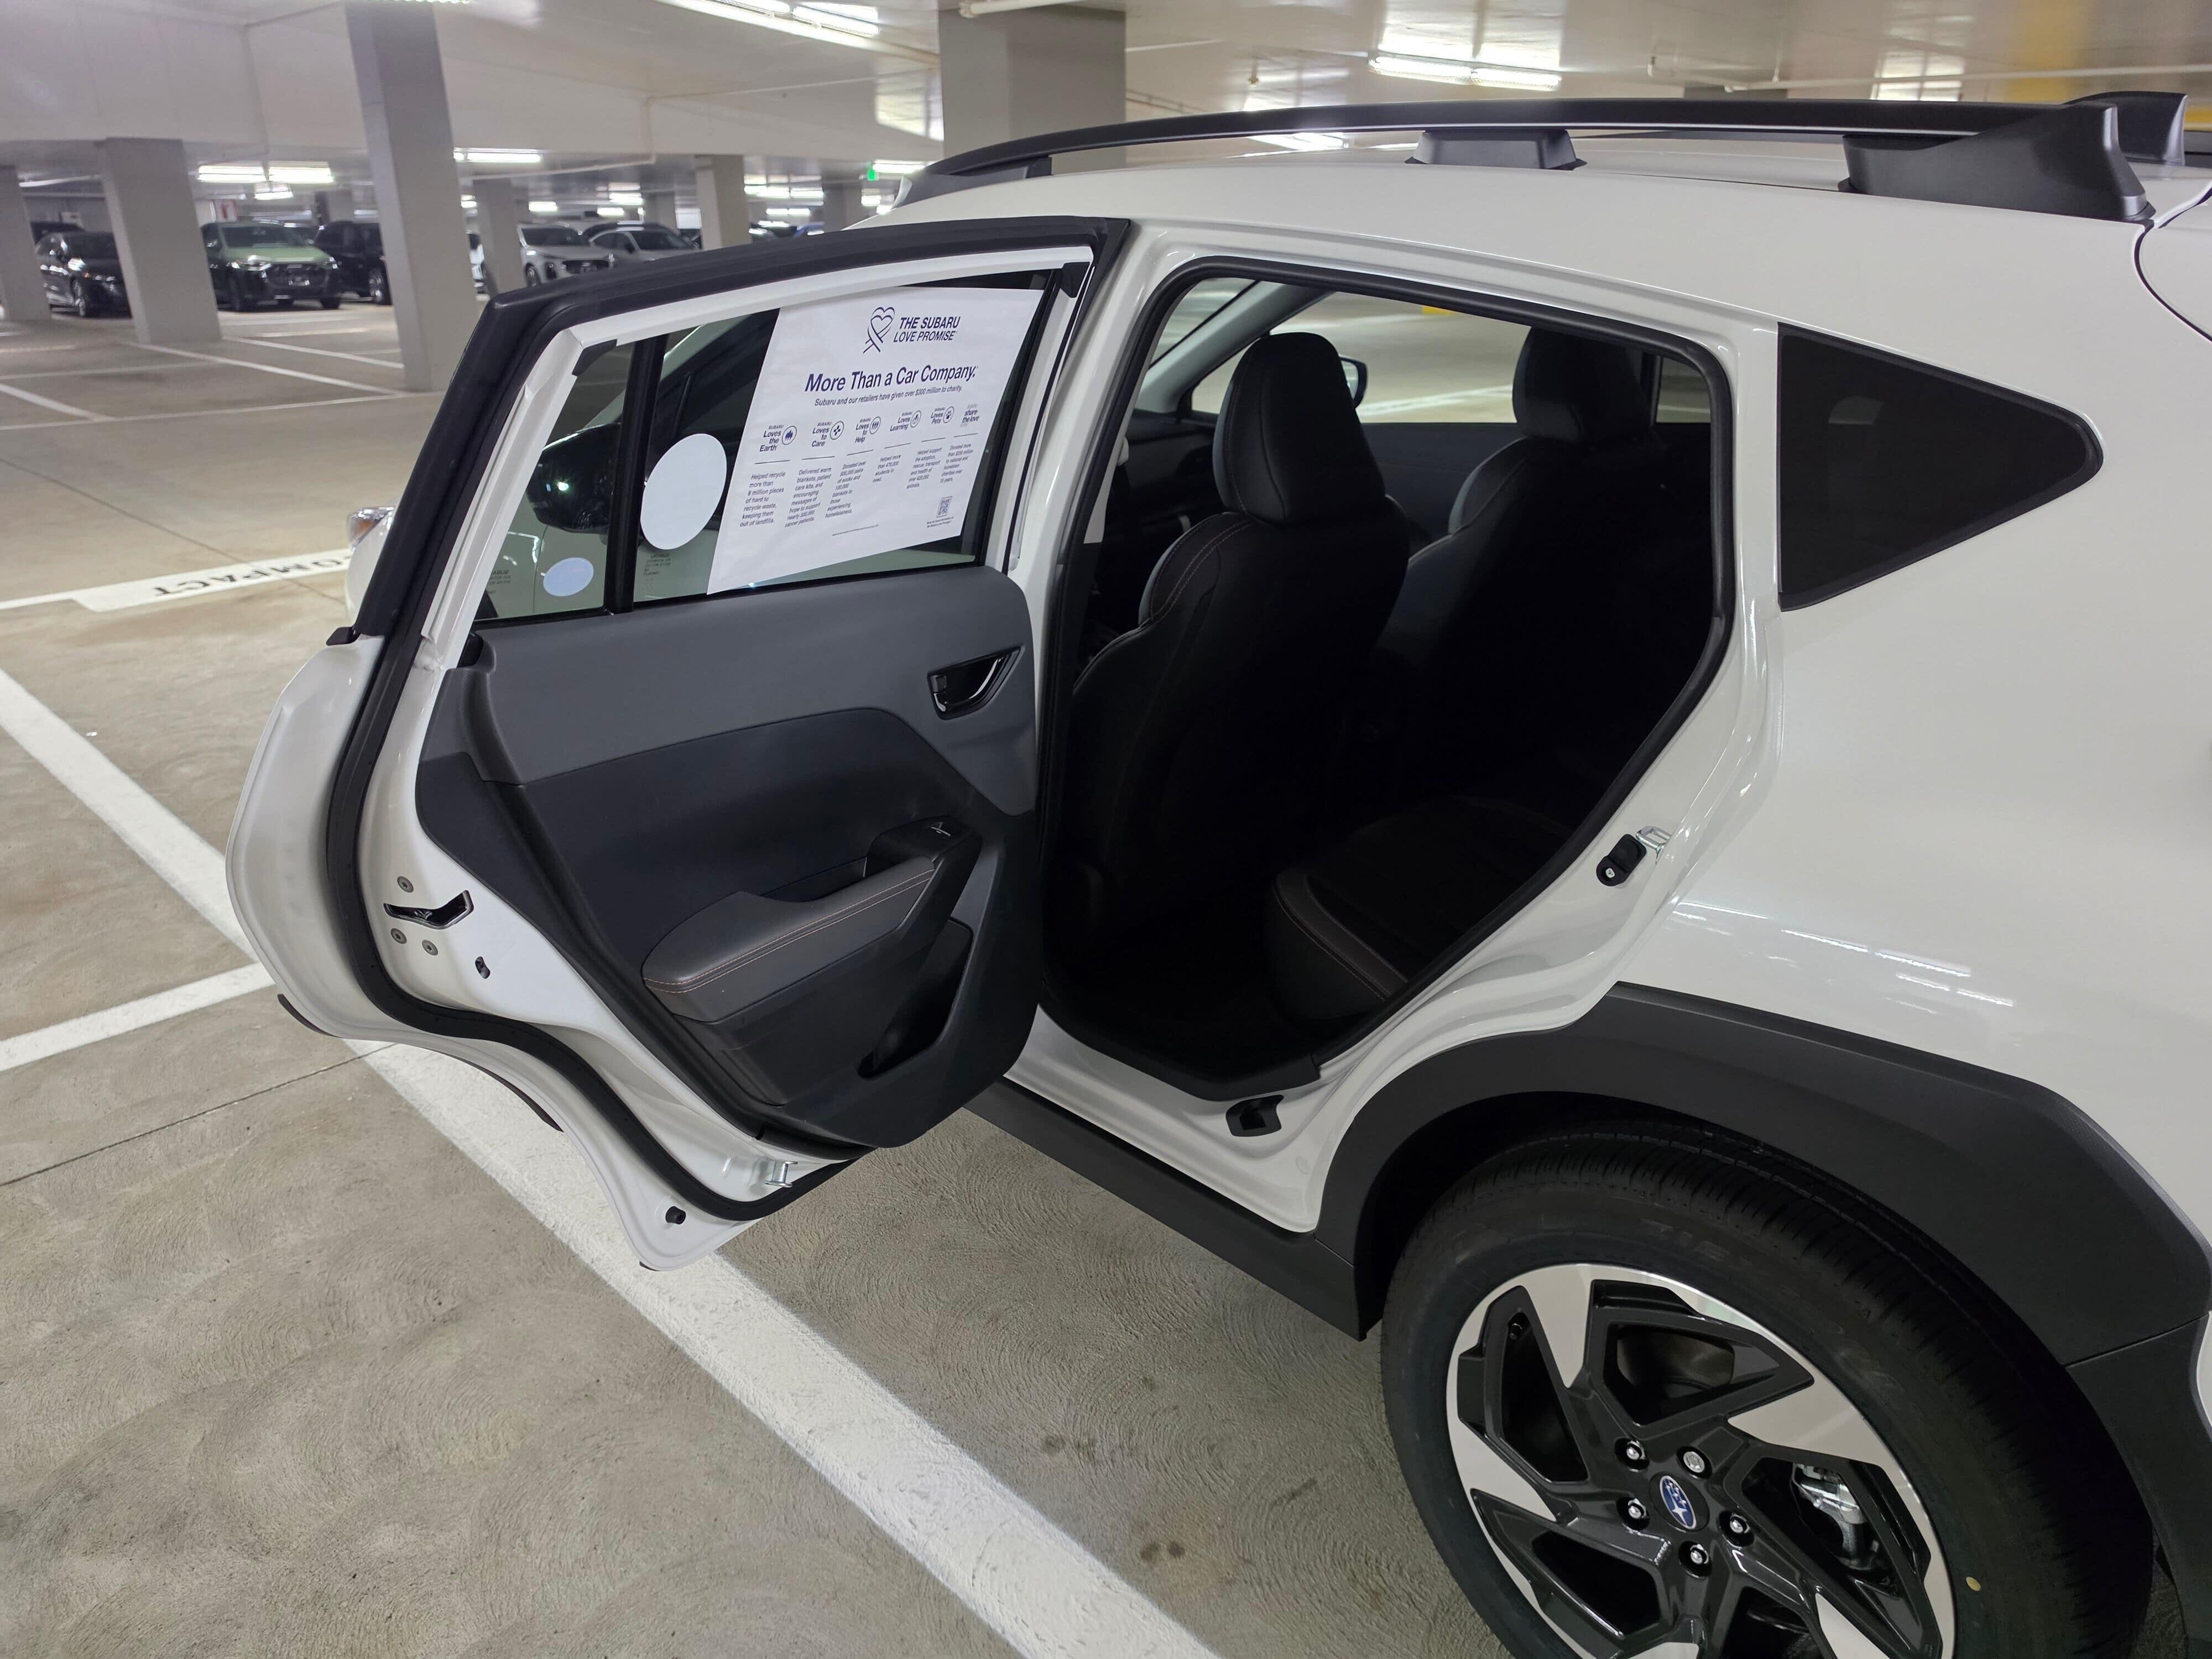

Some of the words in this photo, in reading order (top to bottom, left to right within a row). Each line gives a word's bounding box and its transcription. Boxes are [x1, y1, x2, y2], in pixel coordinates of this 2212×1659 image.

[899, 317, 920, 329] THE
[921, 317, 961, 328] SUBARU
[894, 331, 917, 342] LOVE
[805, 373, 846, 392] More
[851, 371, 881, 389] Than
[884, 372, 893, 386] a
[896, 367, 919, 384] Car
[858, 394, 878, 403] retailers
[879, 393, 890, 401] have
[891, 392, 904, 400] given
[827, 503, 851, 511] experiencing
[154, 556, 351, 597] OMPACT
